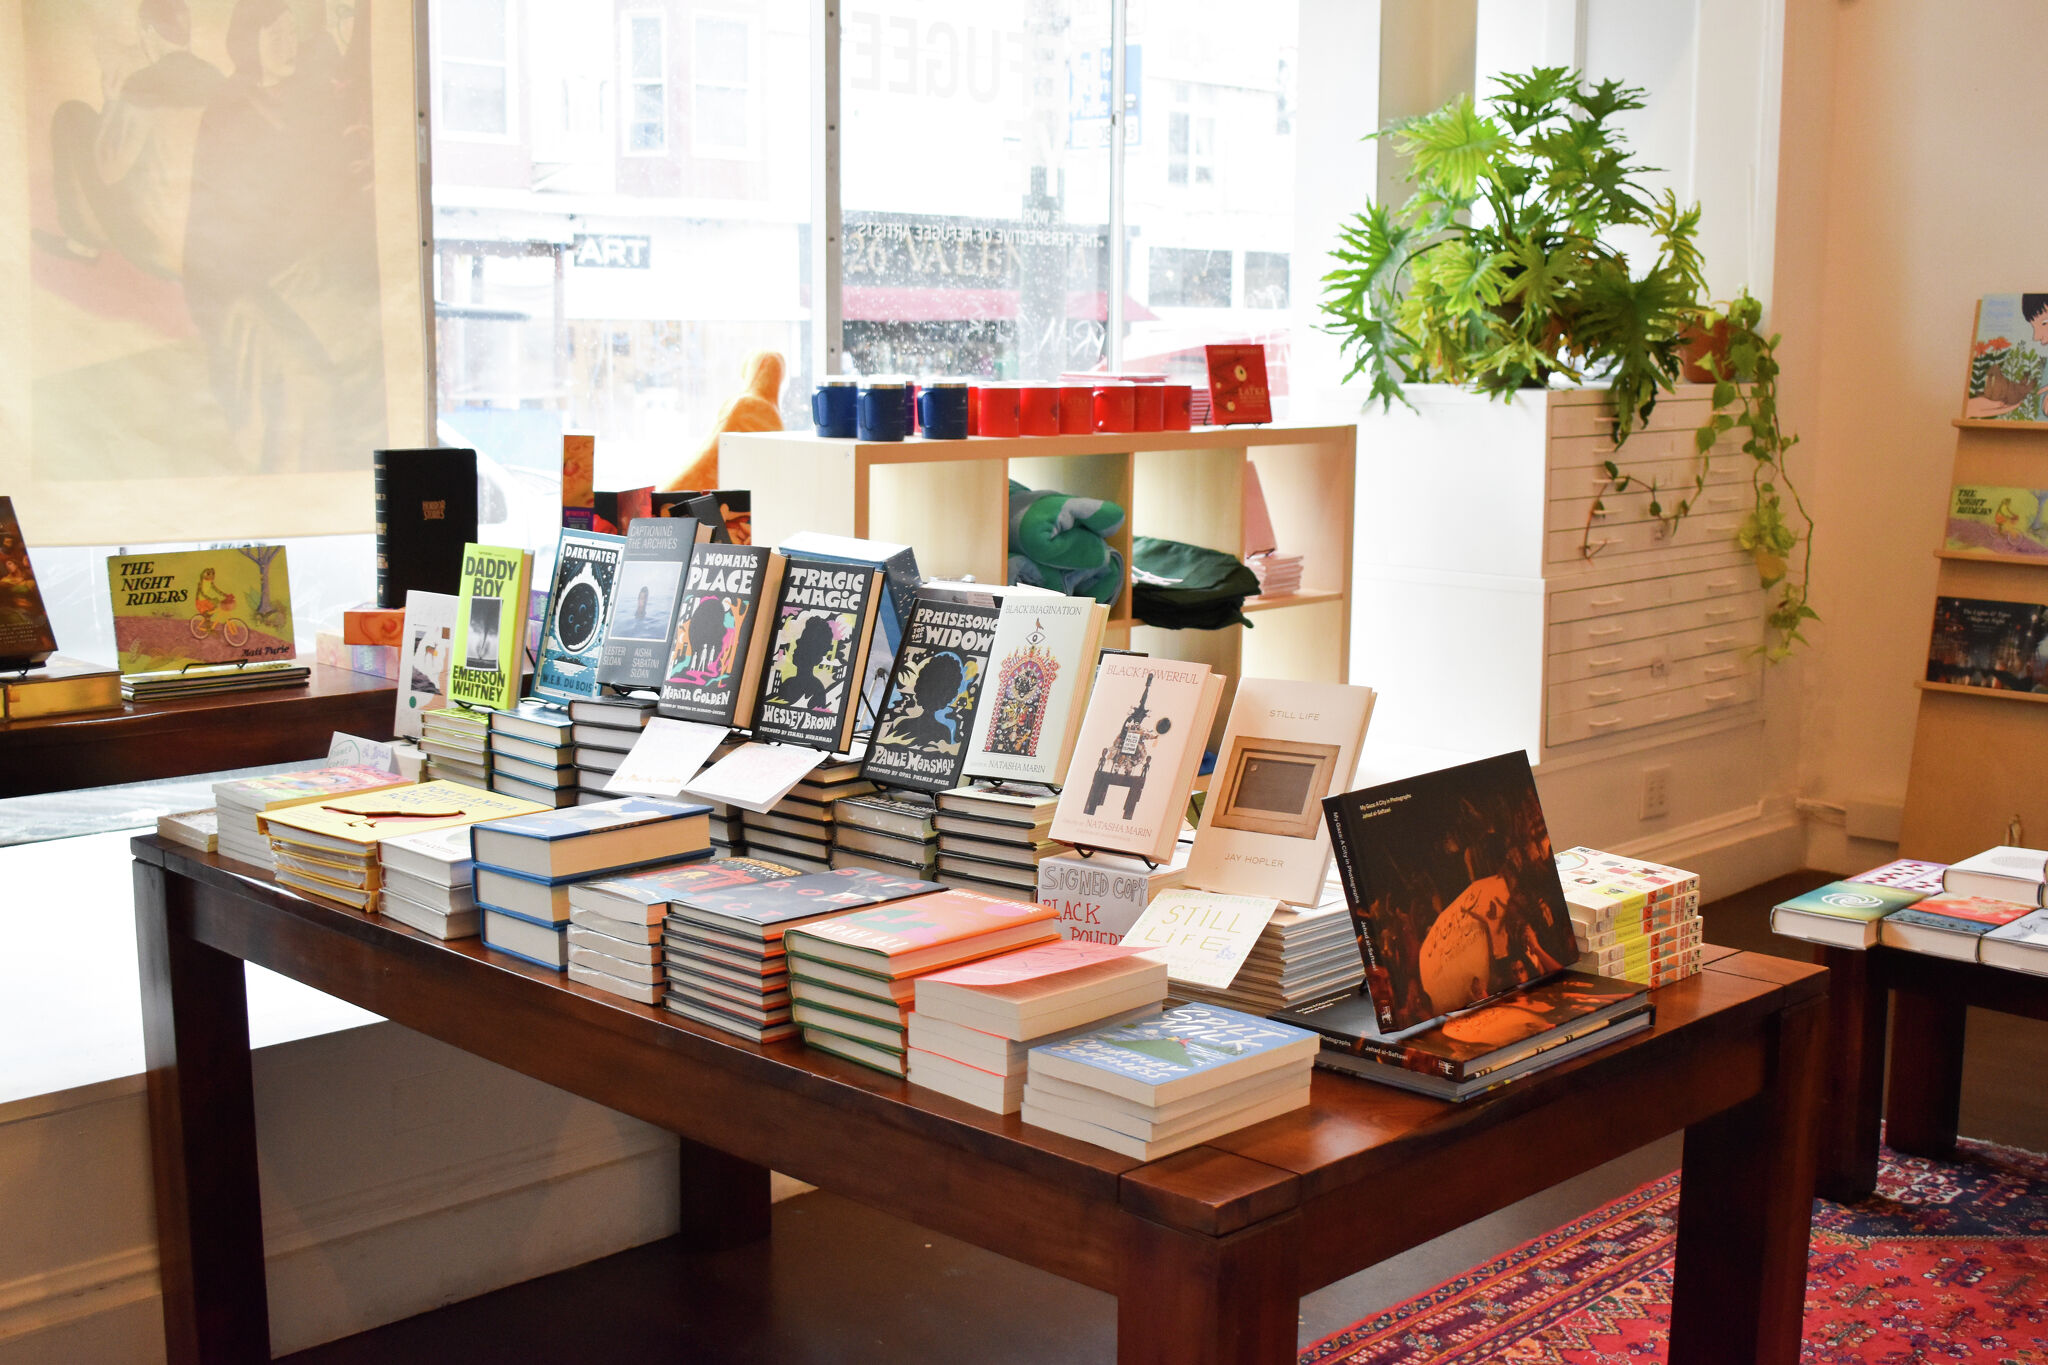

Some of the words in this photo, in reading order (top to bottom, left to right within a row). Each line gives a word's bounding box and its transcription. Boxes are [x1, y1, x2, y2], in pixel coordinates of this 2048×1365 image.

[577, 236, 647, 266] ART
[630, 525, 673, 537] CAPTIONING
[628, 538, 641, 549] THE
[642, 538, 678, 550] ARCHIVES
[565, 545, 617, 564] DARKWATER
[692, 554, 701, 565] A
[120, 561, 155, 576] THE
[465, 557, 517, 580] DADDY
[121, 576, 174, 592] NIGHT
[473, 577, 504, 598] BOY
[688, 565, 756, 594] PLACE
[790, 567, 865, 591] TRAGIC
[126, 590, 188, 606] RIDERS
[915, 608, 999, 631] PRAISESONG
[1005, 605, 1030, 615] BLACK
[1030, 605, 1083, 616] IMAGINATION
[926, 625, 995, 652] WIDOW
[602, 656, 622, 665] SLOAN
[604, 646, 626, 656] LESTER
[634, 647, 652, 656] AISHA
[452, 664, 505, 688] EMERSON
[630, 668, 649, 678] SLOAN
[1106, 664, 1142, 678] BLACK
[1142, 667, 1200, 686] POWERFUL
[452, 680, 504, 703] WHITNEY
[564, 678, 574, 688] DU
[576, 680, 592, 693] BOIS
[692, 690, 731, 705] GOLDEN
[762, 704, 803, 729] WESLEY
[801, 710, 838, 730] BROWN
[1269, 709, 1296, 721] STILL
[1298, 712, 1321, 721] LIFE
[870, 746, 908, 767] PAULE
[989, 759, 1021, 770] NATASHA
[1023, 763, 1046, 774] MARIN
[1087, 819, 1124, 833] NATASHA
[1125, 825, 1153, 838] MARIN
[1224, 852, 1241, 862] JAY
[1245, 854, 1284, 868] HOPLER
[1113, 876, 1149, 907] COPY
[1347, 865, 1361, 904] Photographs
[1070, 926, 1125, 946] POWER
[1360, 920, 1370, 942] Jehad
[1171, 1008, 1289, 1039] SPILT
[1142, 1019, 1263, 1052] MILK
[1069, 1038, 1189, 1073] COURTNEY
[1365, 1045, 1381, 1055] Jehad
[1381, 1050, 1409, 1061] al-Saftawi
